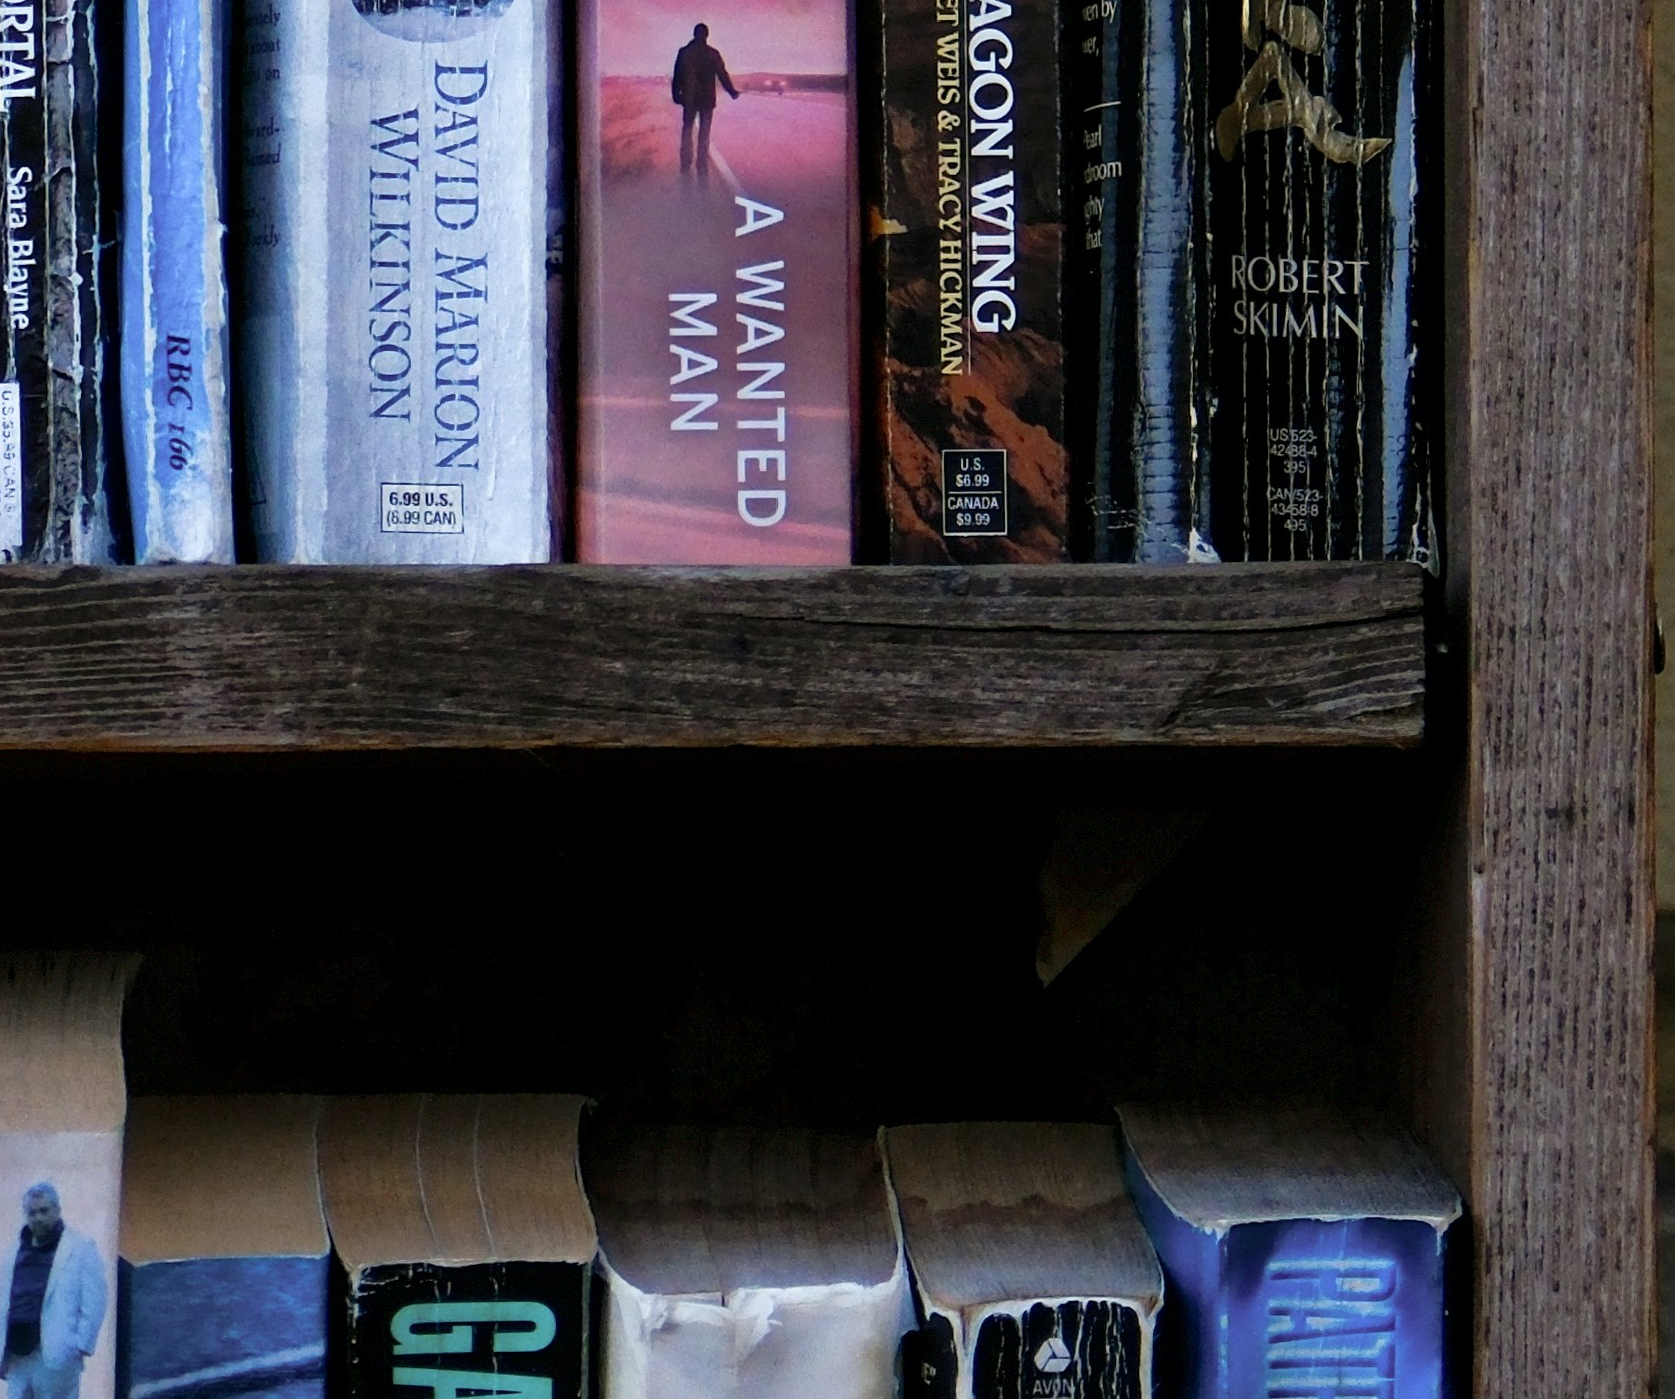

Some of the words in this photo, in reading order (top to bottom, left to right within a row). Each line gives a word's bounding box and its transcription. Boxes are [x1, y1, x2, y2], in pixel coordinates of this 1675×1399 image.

[971, 170, 1017, 334] WING
[1229, 255, 1371, 296] ROBERT
[1232, 302, 1365, 340] SKIMIN
[163, 332, 195, 411] RBC
[1031, 1378, 1073, 1397] AVON
